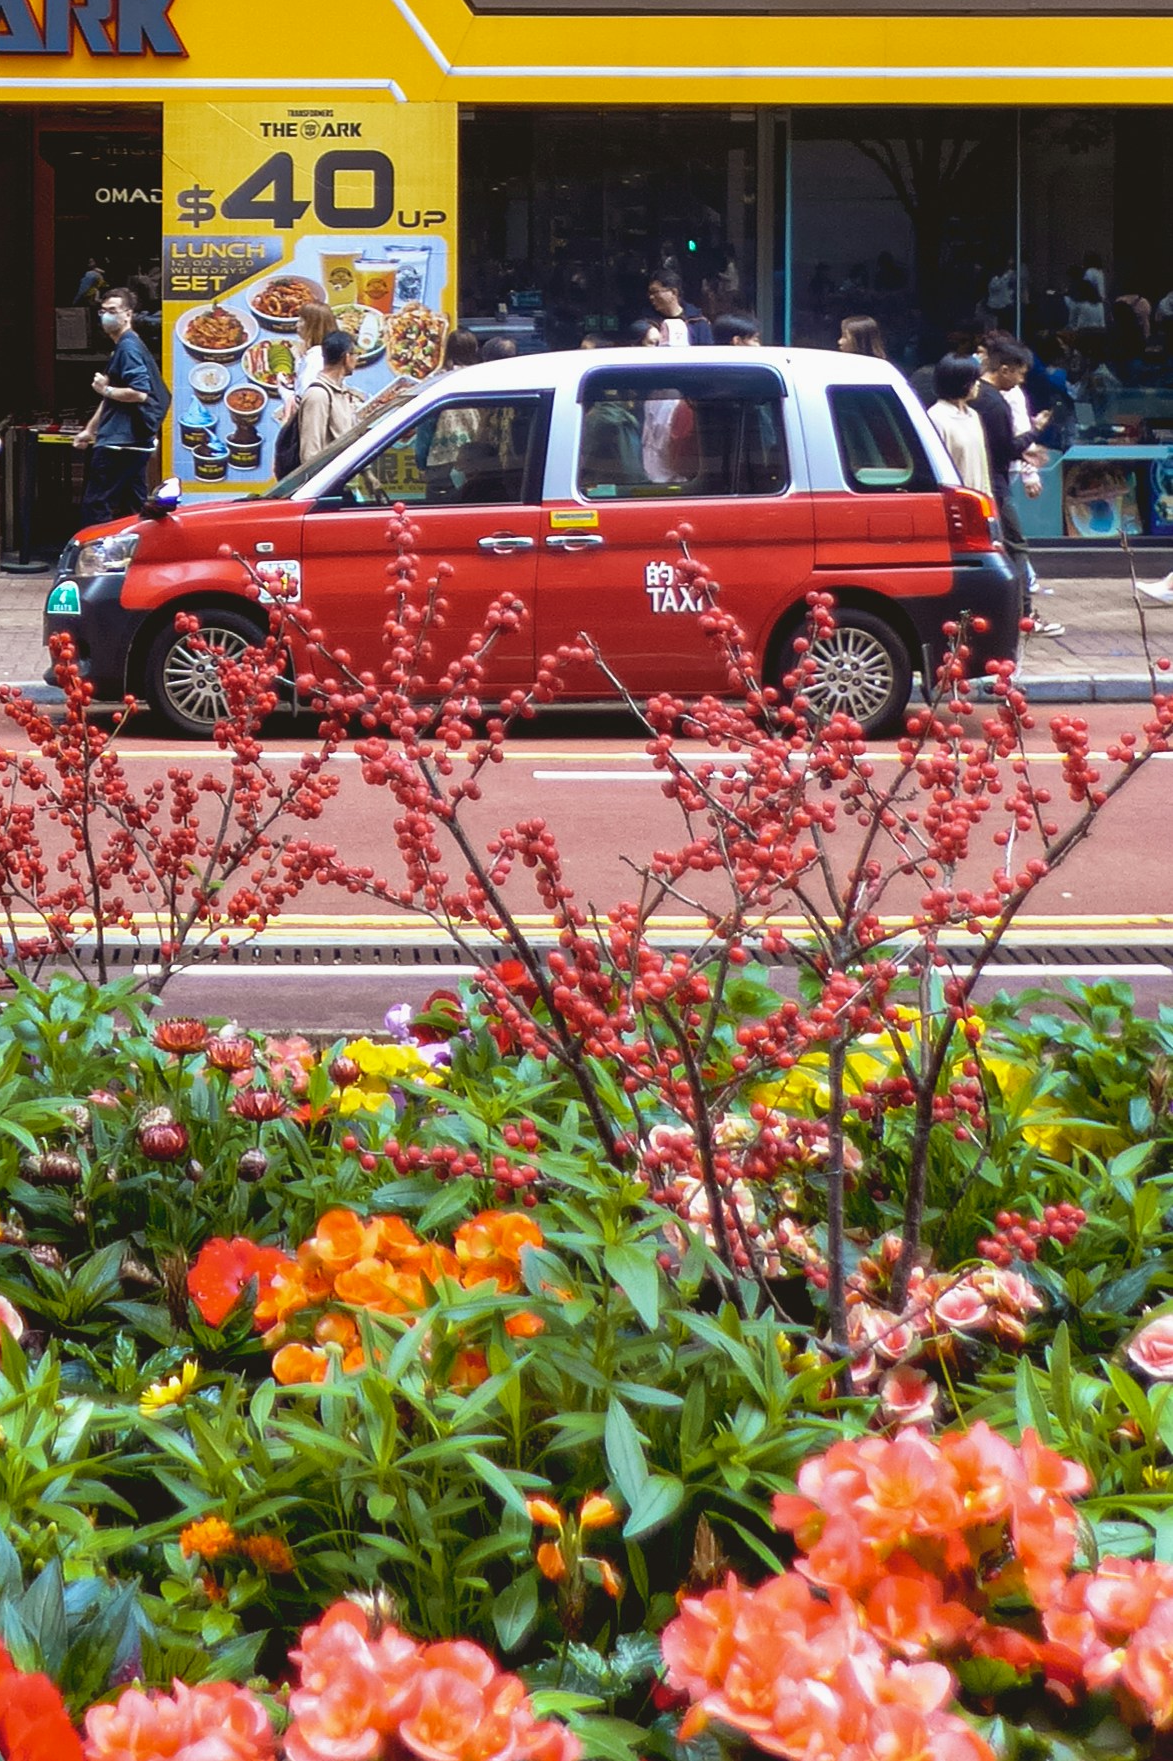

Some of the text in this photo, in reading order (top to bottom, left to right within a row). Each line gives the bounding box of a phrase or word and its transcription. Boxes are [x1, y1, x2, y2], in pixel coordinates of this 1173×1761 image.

[259, 121, 362, 138] THE ARK
[176, 149, 447, 229] $40 UP
[170, 242, 266, 259] LUNCH
[170, 267, 249, 275] WEEKDAYS
[170, 276, 226, 292] SET
